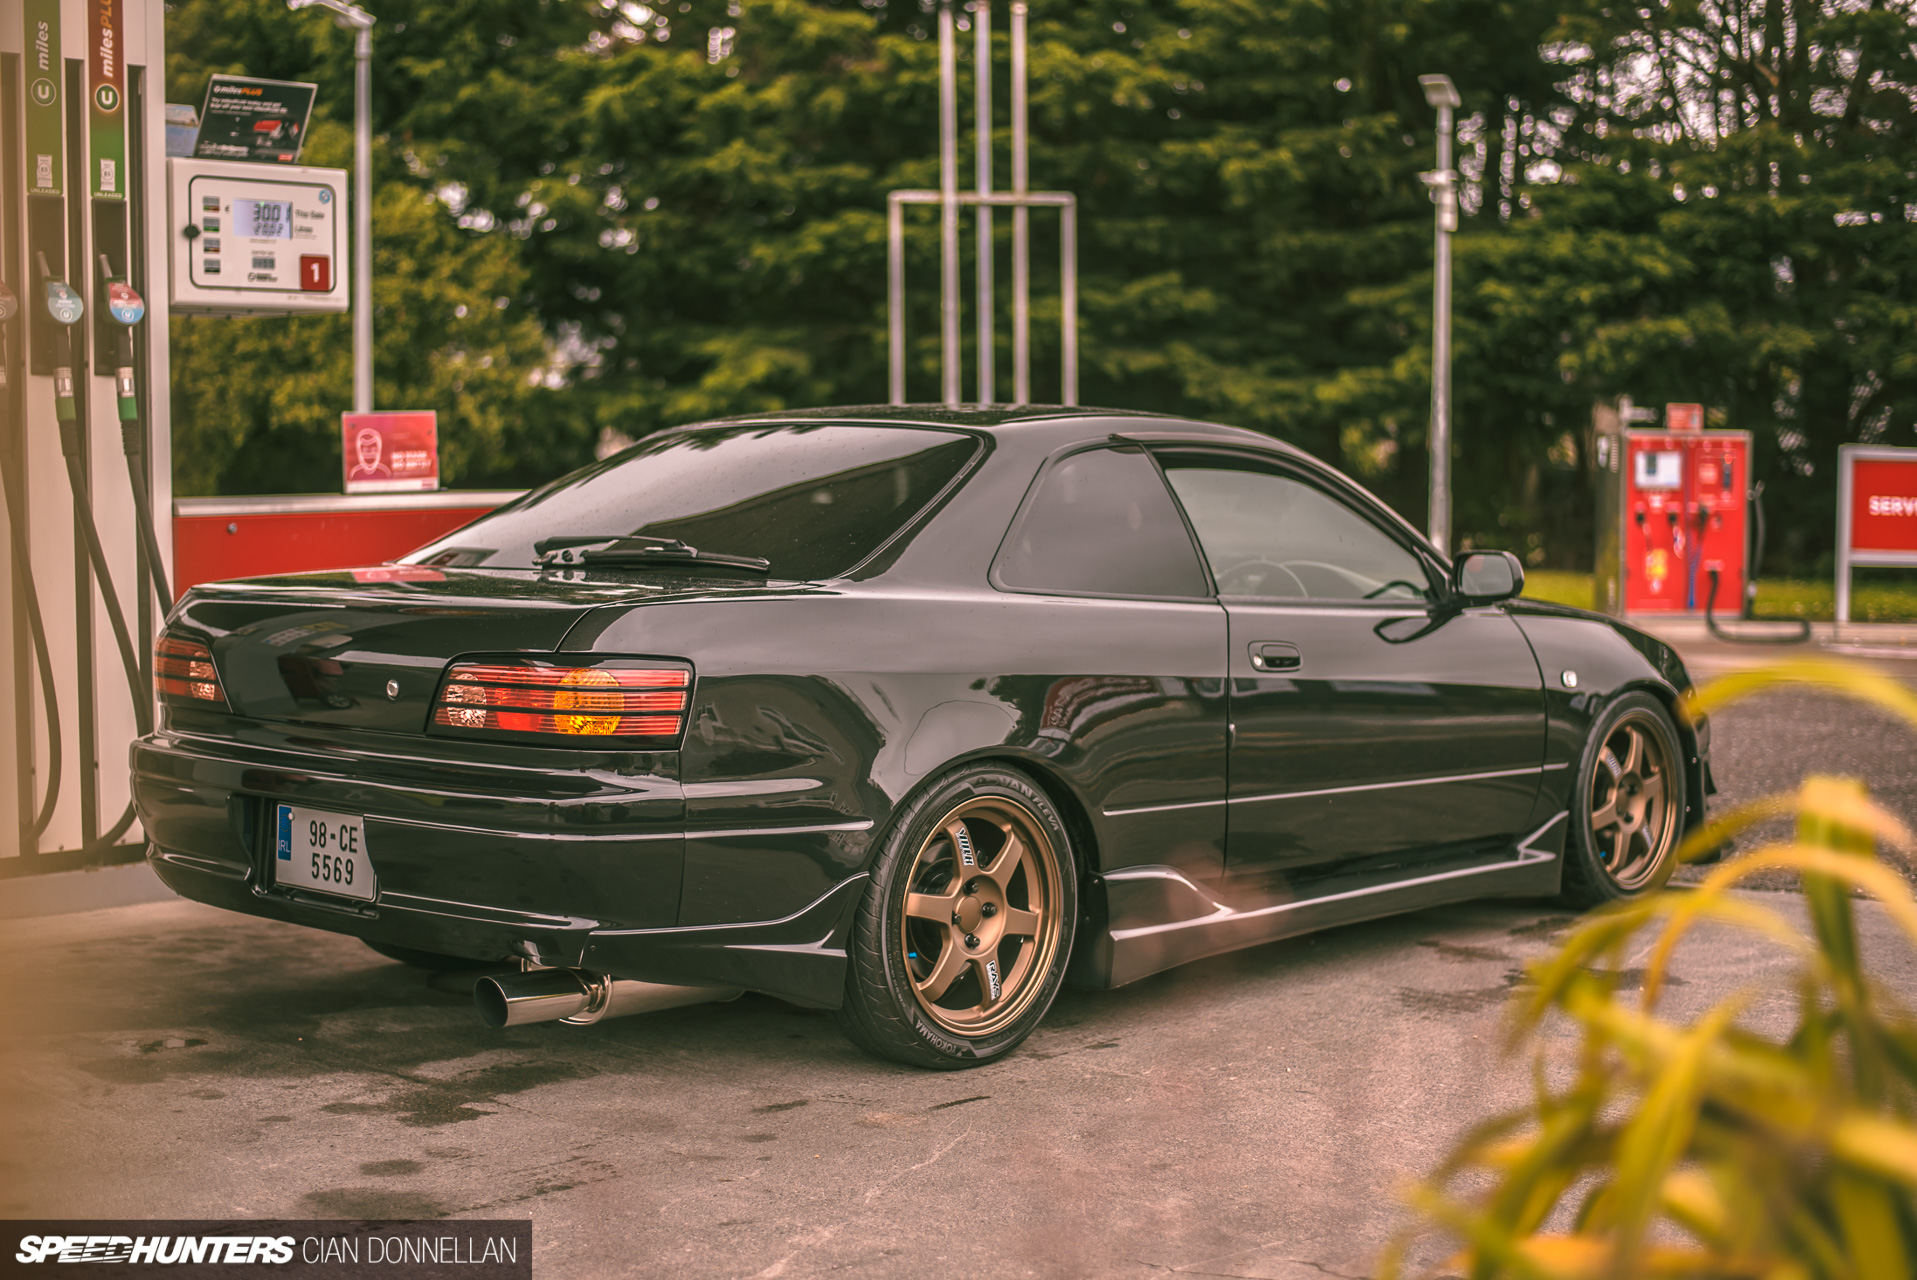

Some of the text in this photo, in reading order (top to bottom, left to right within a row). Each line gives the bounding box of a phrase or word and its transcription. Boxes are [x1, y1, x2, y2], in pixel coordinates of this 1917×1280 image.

[36, 20, 50, 71] miles
[310, 262, 320, 283] 1
[1032, 797, 1059, 831] FLEVA
[278, 839, 291, 853] IRL
[309, 820, 358, 853] 98-CE
[311, 852, 354, 886] 5569
[989, 961, 1000, 998] RAYS
[915, 1018, 958, 1054] YOKOHAMA
